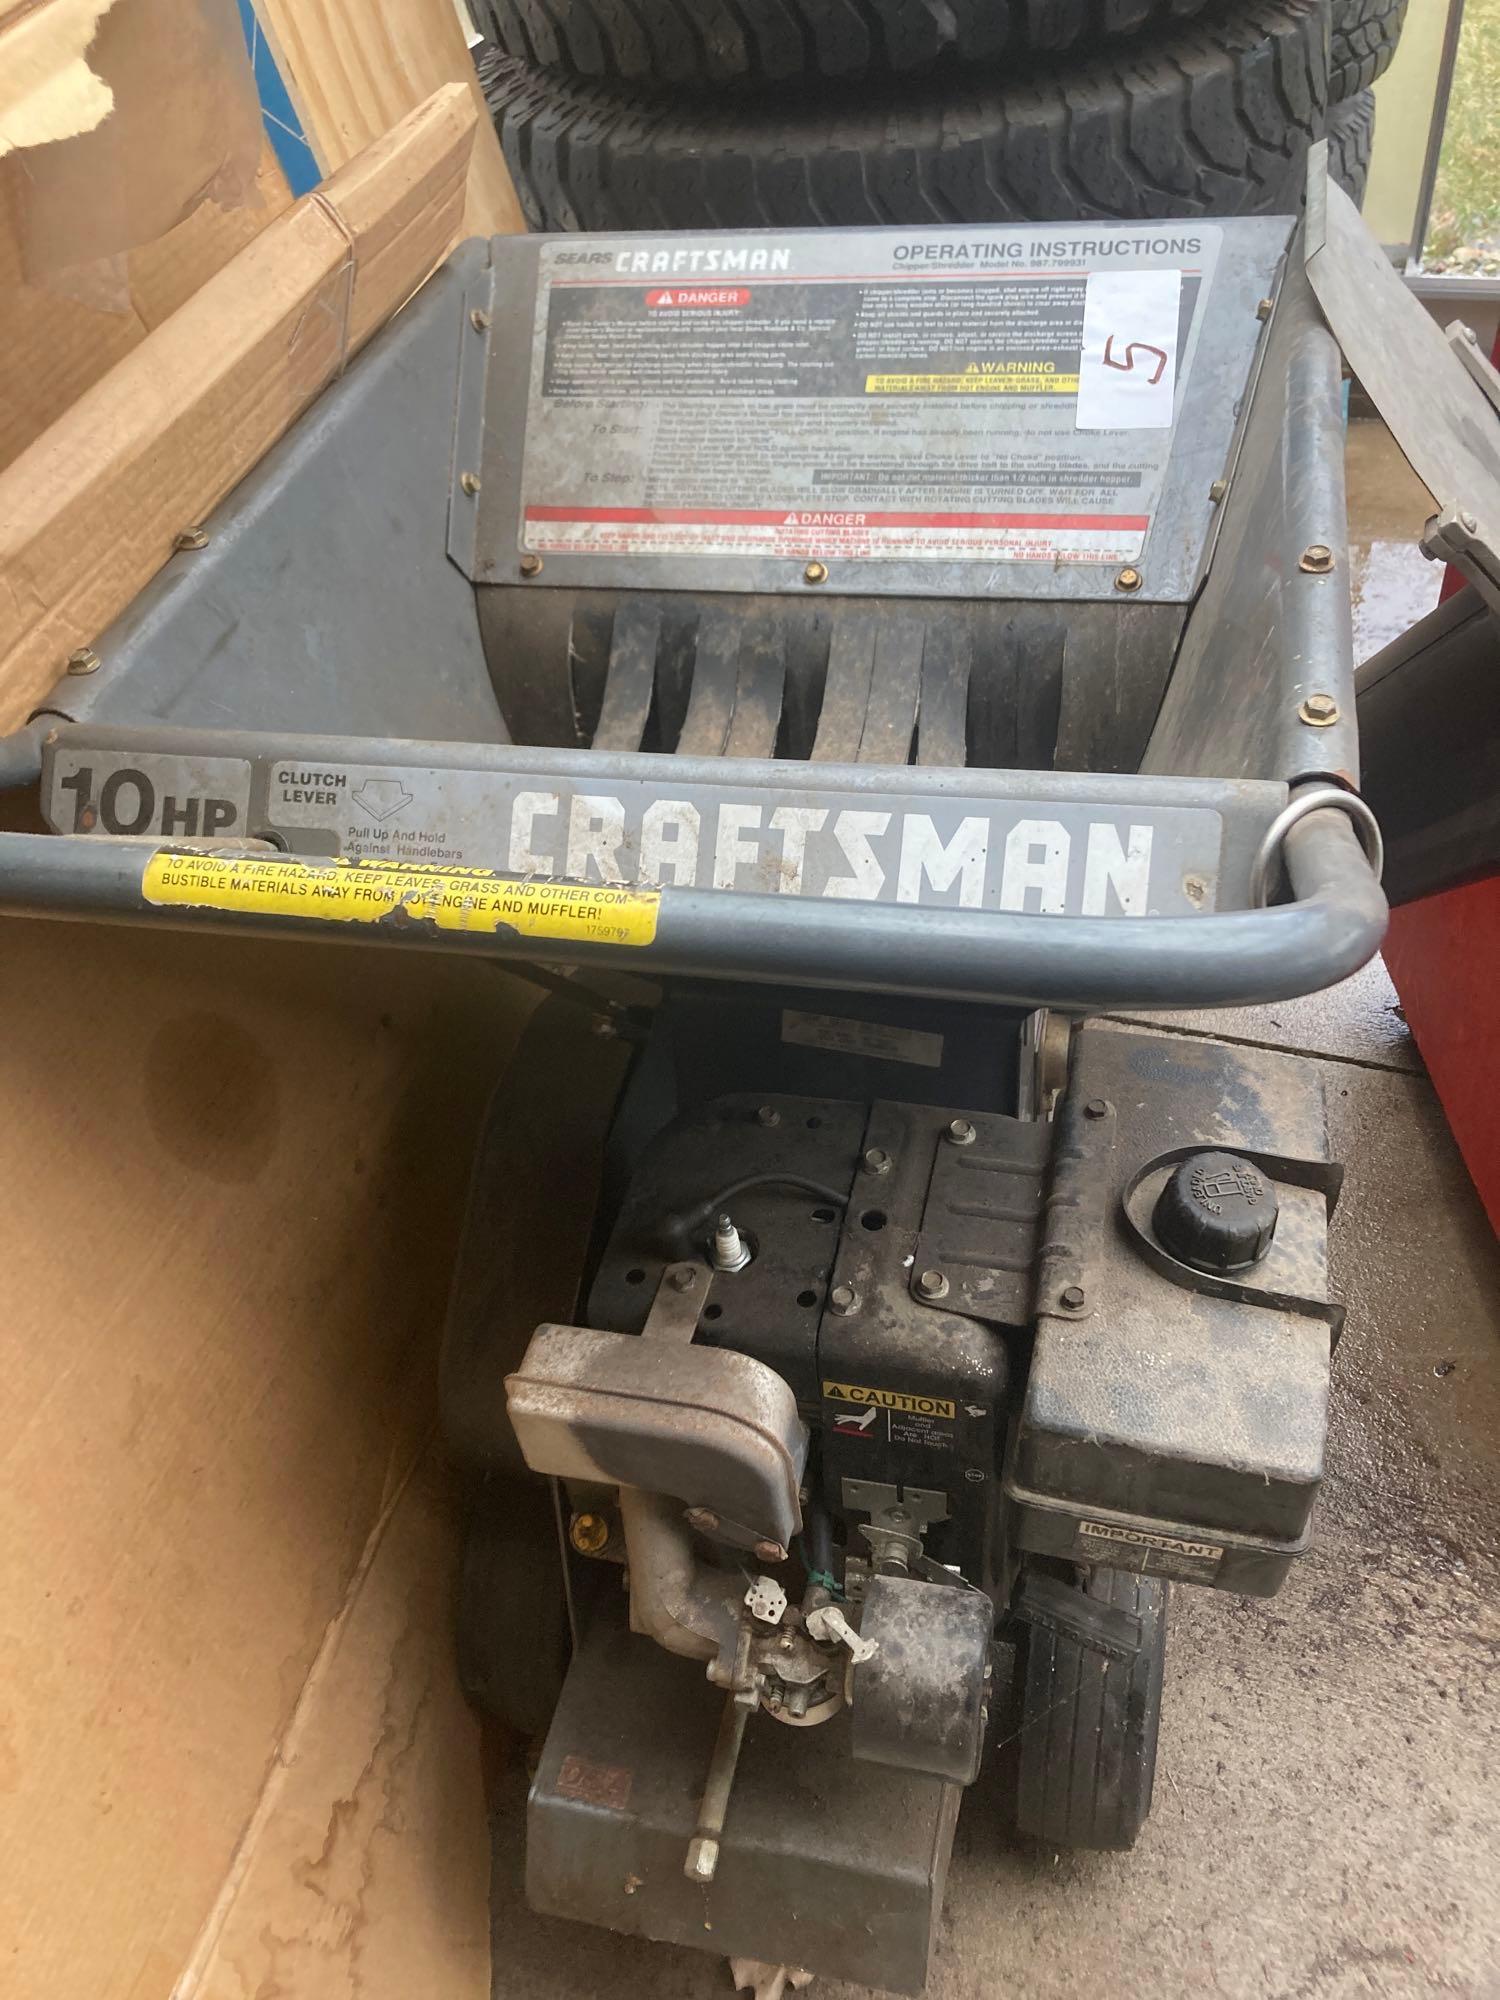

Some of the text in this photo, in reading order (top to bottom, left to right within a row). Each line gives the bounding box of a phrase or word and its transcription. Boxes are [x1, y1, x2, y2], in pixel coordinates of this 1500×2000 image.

[554, 248, 791, 273] SEARS CRAFTSMAN
[893, 238, 1201, 262] OPERATING INSTRUCTIONS
[678, 291, 738, 303] DANGER
[981, 362, 1056, 372] WARNING
[801, 514, 866, 526] DANGER
[279, 771, 346, 787] CLUTCH
[283, 789, 337, 805] LEVER
[348, 826, 446, 844] Pull Up And Hold
[347, 841, 463, 859] Against Handlebars
[508, 790, 1154, 917] CRAFTSMAN
[167, 859, 183, 870] TO
[187, 860, 229, 873] AVOID
[230, 863, 240, 874] A
[243, 864, 273, 876] FIRE
[344, 872, 383, 885] KEEP
[450, 880, 499, 895] GRASS
[503, 884, 535, 898] AND
[540, 888, 590, 903] OTHER
[161, 873, 226, 890] BUSTIBLE
[230, 877, 308, 896] MATERIALS
[311, 887, 350, 900] AWAY
[354, 888, 395, 903] FROM
[492, 901, 523, 913] AND
[527, 901, 602, 921] MUFFLER!
[850, 1388, 950, 1416] CAUTION
[1084, 1523, 1220, 1557] IMPORTANT
